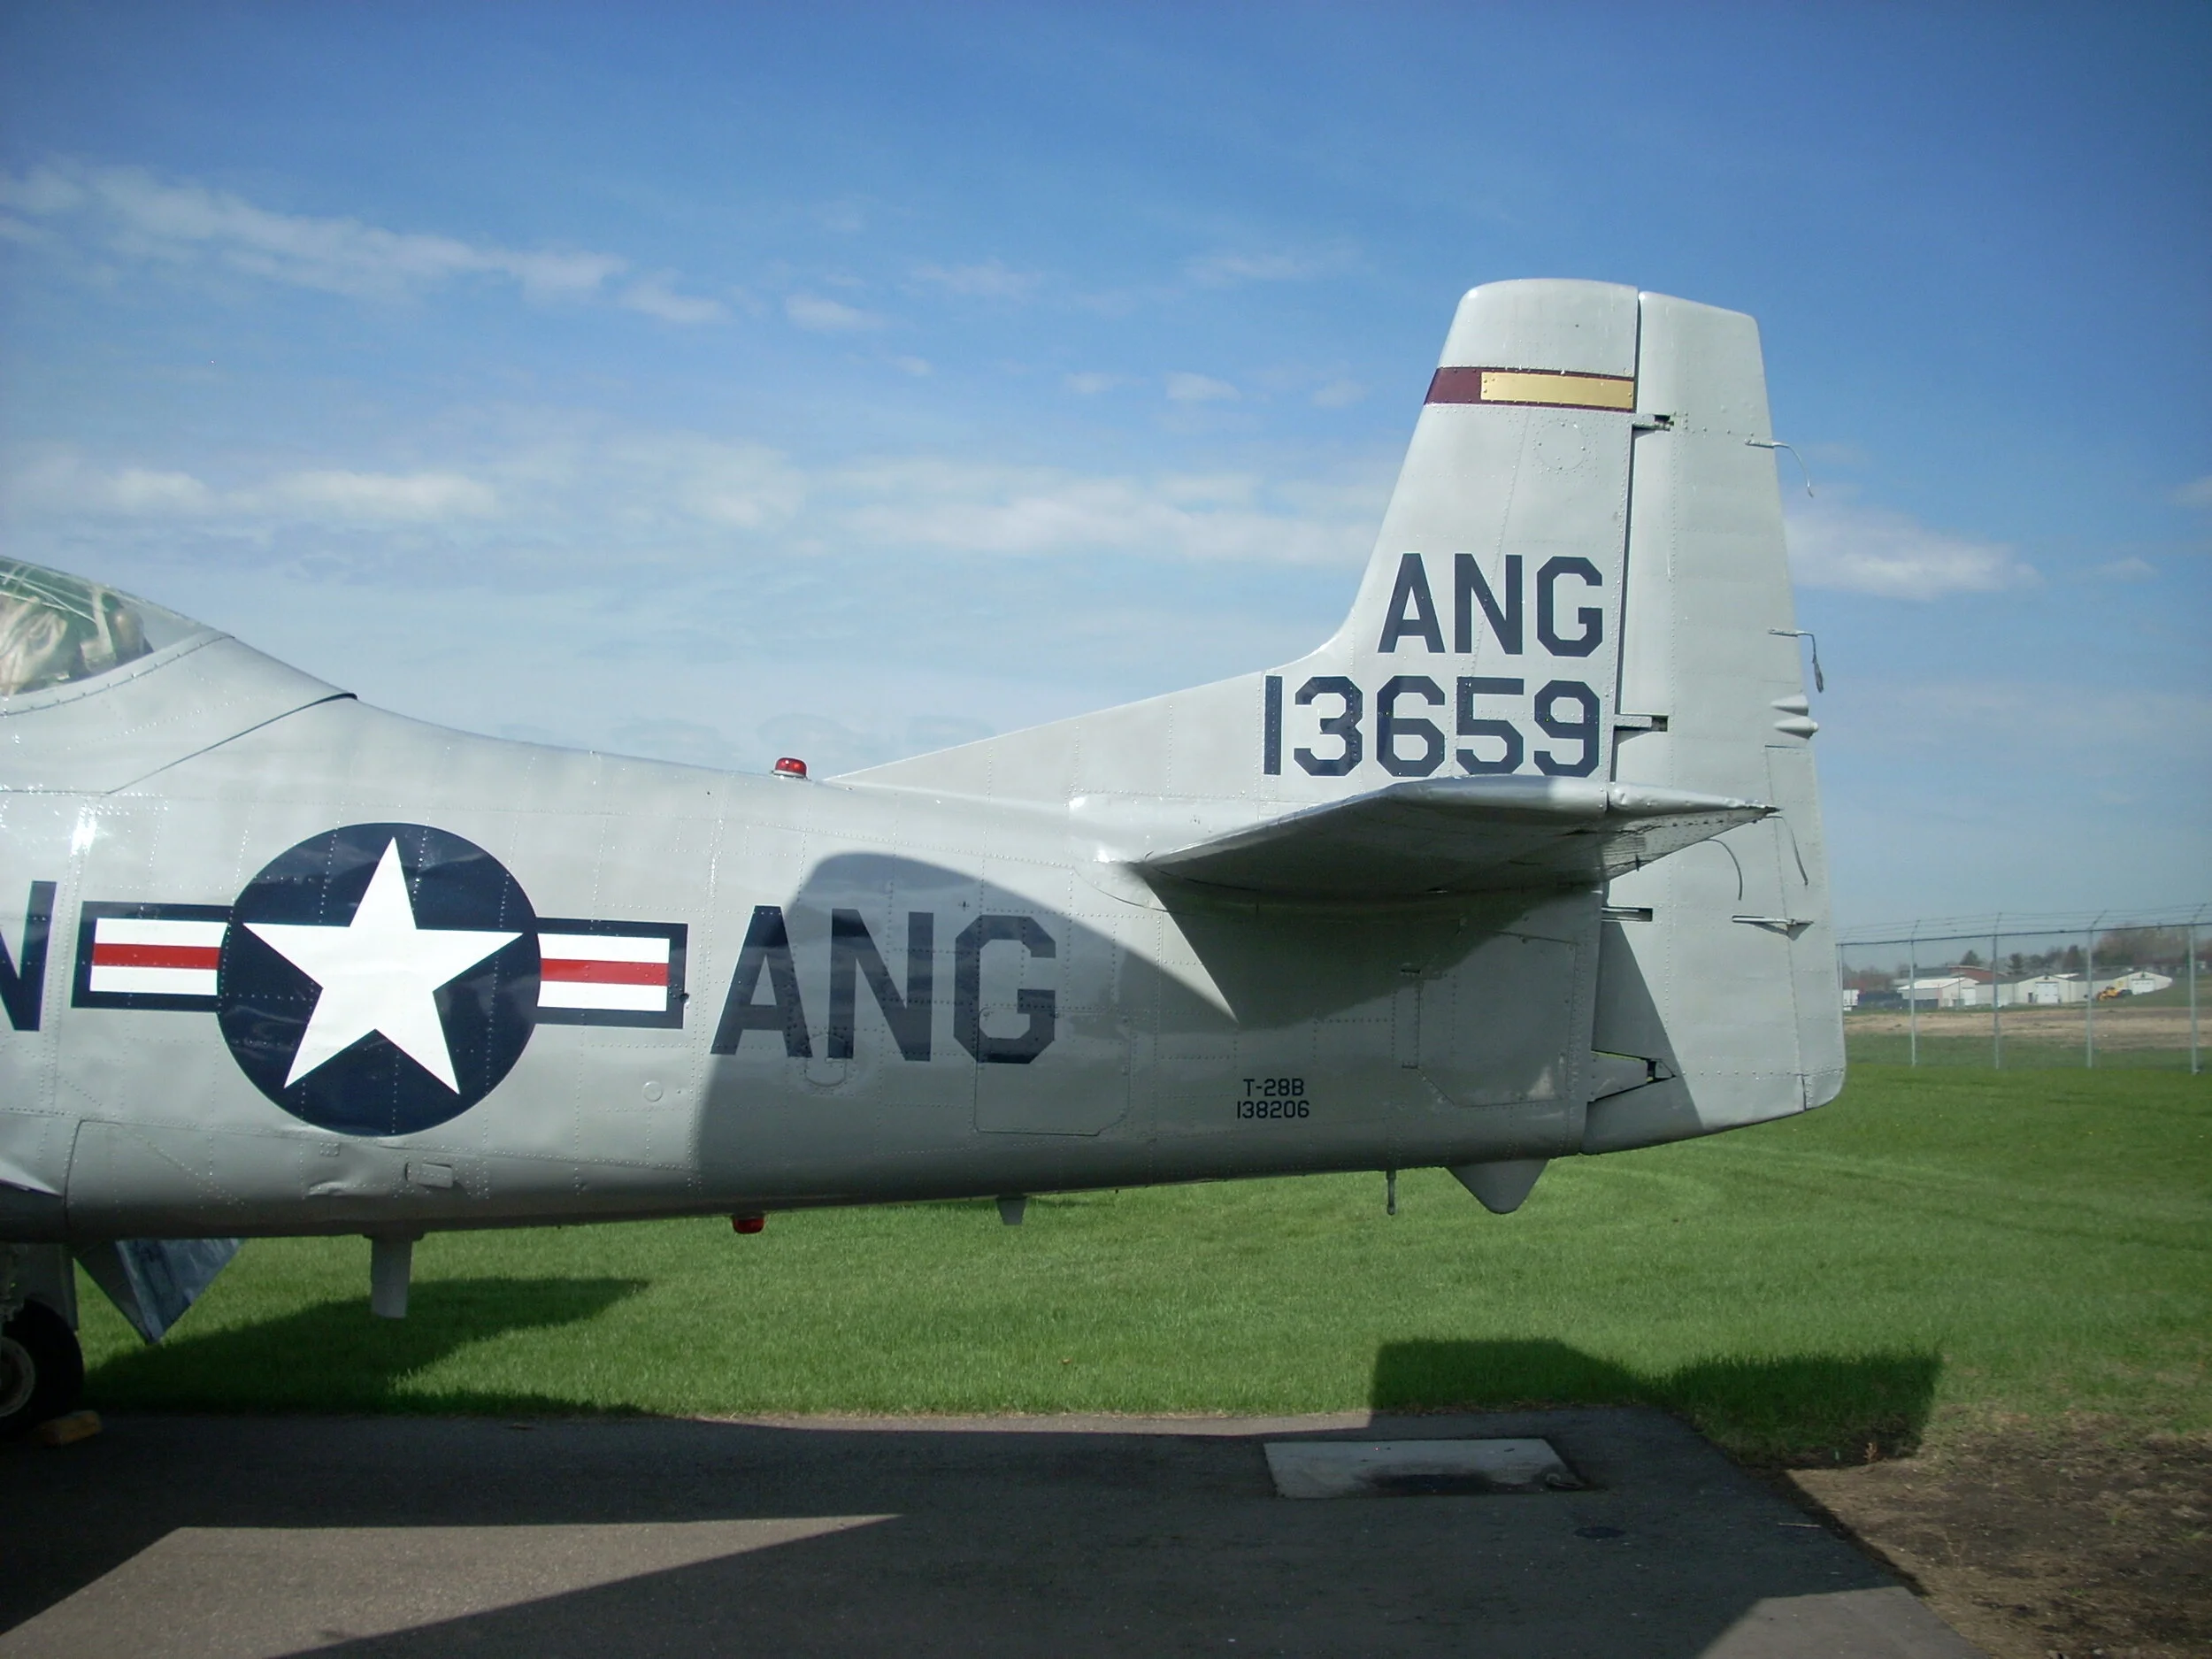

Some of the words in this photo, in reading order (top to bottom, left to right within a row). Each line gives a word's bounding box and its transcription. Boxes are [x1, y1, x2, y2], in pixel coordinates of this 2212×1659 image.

[1377, 552, 1603, 657] ANG
[1263, 674, 1601, 778] 13659
[710, 904, 1057, 1064] ANG
[1236, 1100, 1310, 1119] 138206
[1242, 1078, 1304, 1097] T-28B
